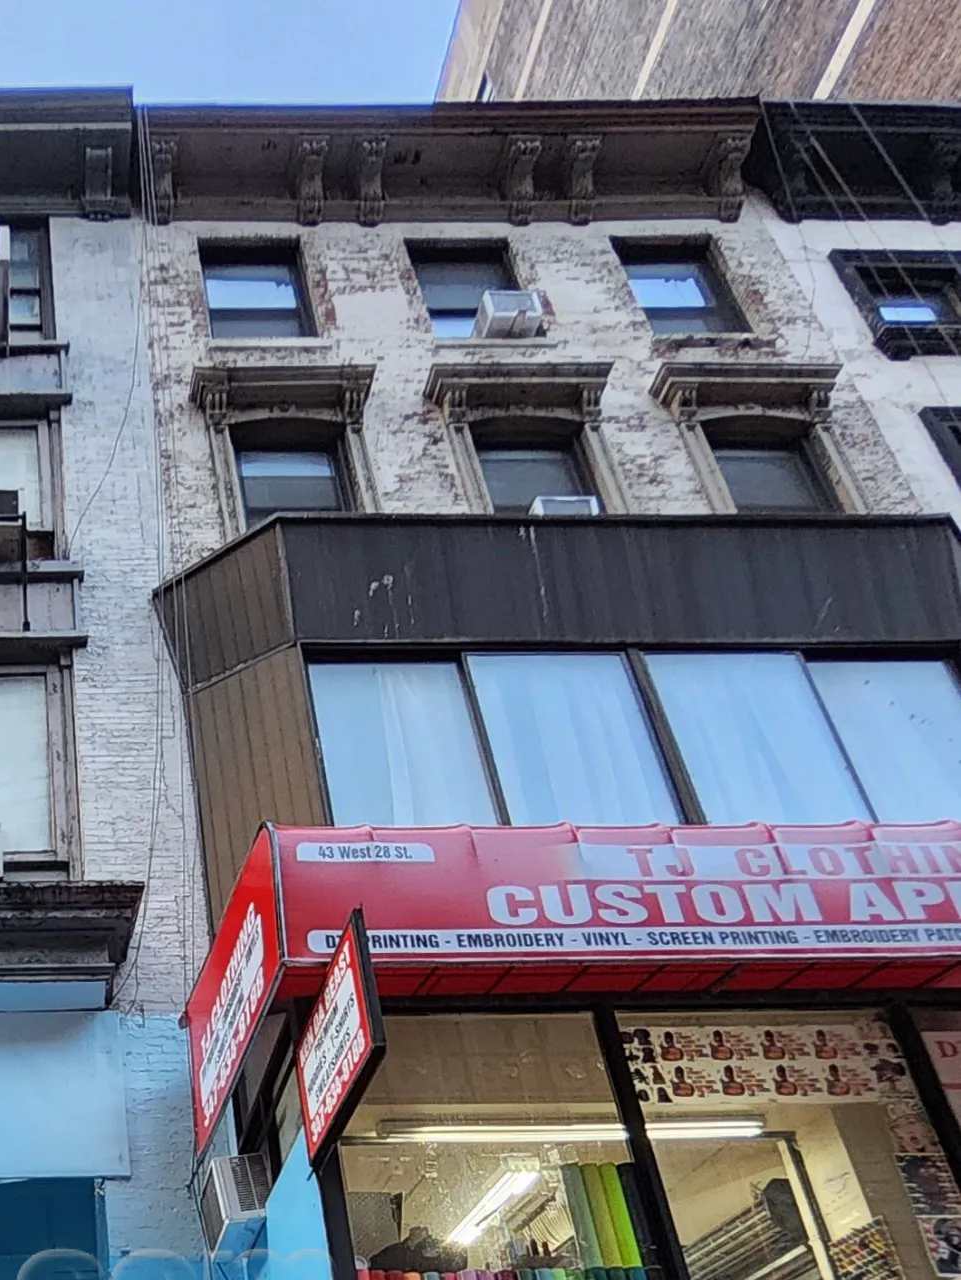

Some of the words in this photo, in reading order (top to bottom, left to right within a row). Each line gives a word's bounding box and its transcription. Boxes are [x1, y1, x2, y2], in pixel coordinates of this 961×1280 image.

[318, 845, 335, 859] 43
[337, 845, 372, 859] West
[374, 845, 392, 859] 28
[625, 847, 695, 877] TJ
[486, 882, 823, 925] CUSTOM
[457, 932, 564, 949] EMBROIDERY
[583, 932, 632, 948] VINYL
[647, 930, 719, 946] SCREEN
[720, 930, 799, 945] PRINTING
[815, 928, 922, 945] EMBROIDERY
[211, 901, 255, 1027] CLOTHING
